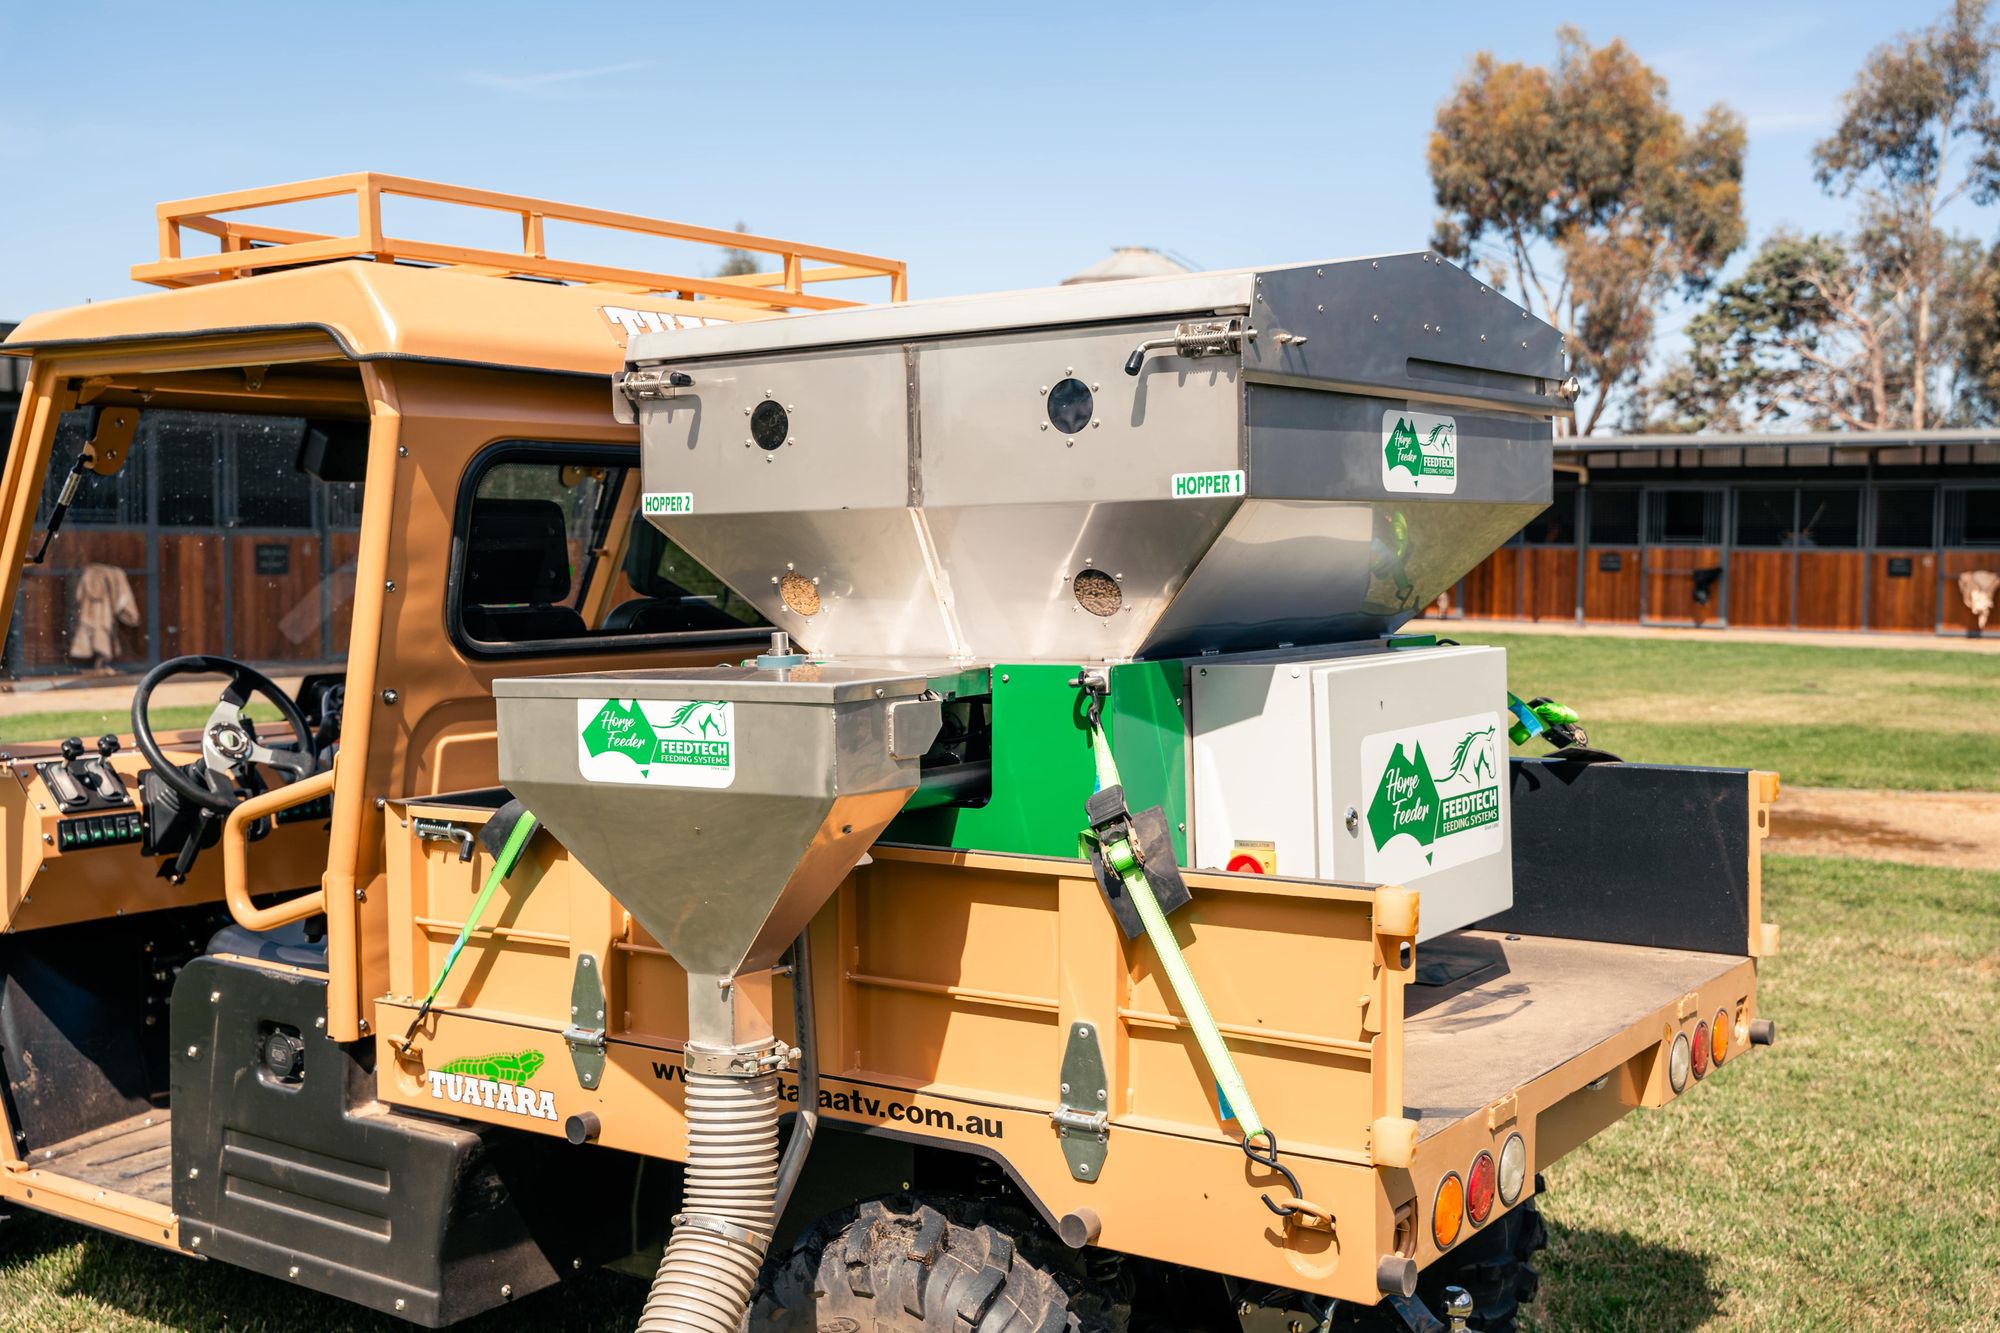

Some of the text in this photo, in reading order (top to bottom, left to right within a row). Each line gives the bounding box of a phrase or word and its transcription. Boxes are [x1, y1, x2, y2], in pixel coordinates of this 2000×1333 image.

[1423, 456, 1454, 468] FEEDTECH
[1176, 473, 1240, 495] HOPPER 1
[645, 495, 690, 512] HOPPER 2
[600, 709, 636, 732] Horse
[606, 730, 646, 749] Feeder
[660, 741, 728, 756] FEEDTECH
[660, 754, 728, 765] FEEDING SYSTEMS
[1385, 767, 1421, 801] Horse
[1391, 797, 1430, 831] Feeder
[1442, 788, 1498, 821] FEEDTECH
[1442, 816, 1470, 833] FEEDING
[1469, 808, 1498, 826] SYSTEMS
[428, 1069, 558, 1121] TUATARA
